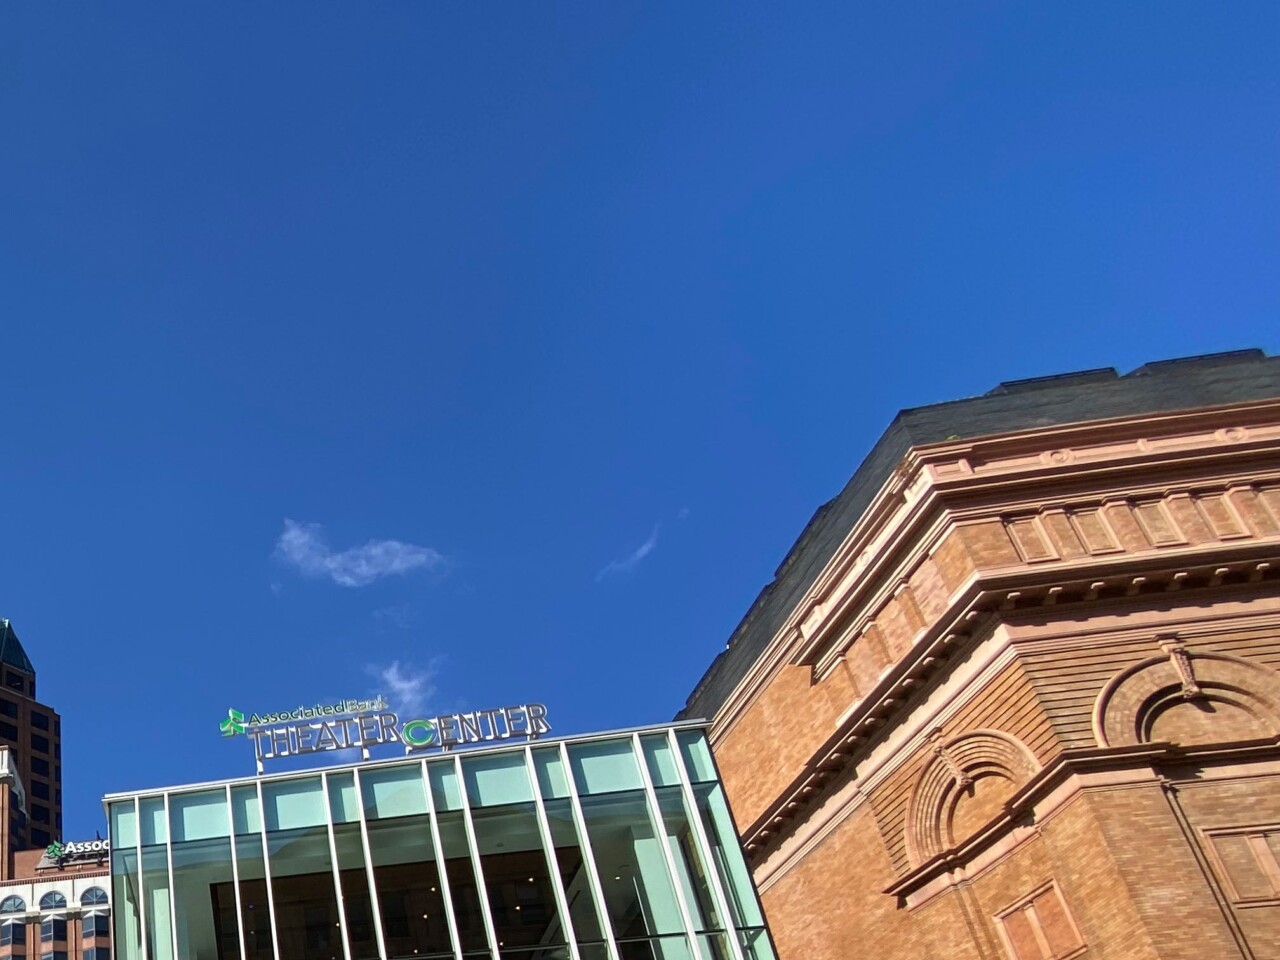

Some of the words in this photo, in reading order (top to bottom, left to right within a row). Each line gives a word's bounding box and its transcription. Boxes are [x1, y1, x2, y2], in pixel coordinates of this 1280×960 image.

[247, 713, 402, 759] THEATER
[402, 703, 552, 748] CENTER
[248, 700, 345, 726] Associated
[346, 694, 389, 712] Bank
